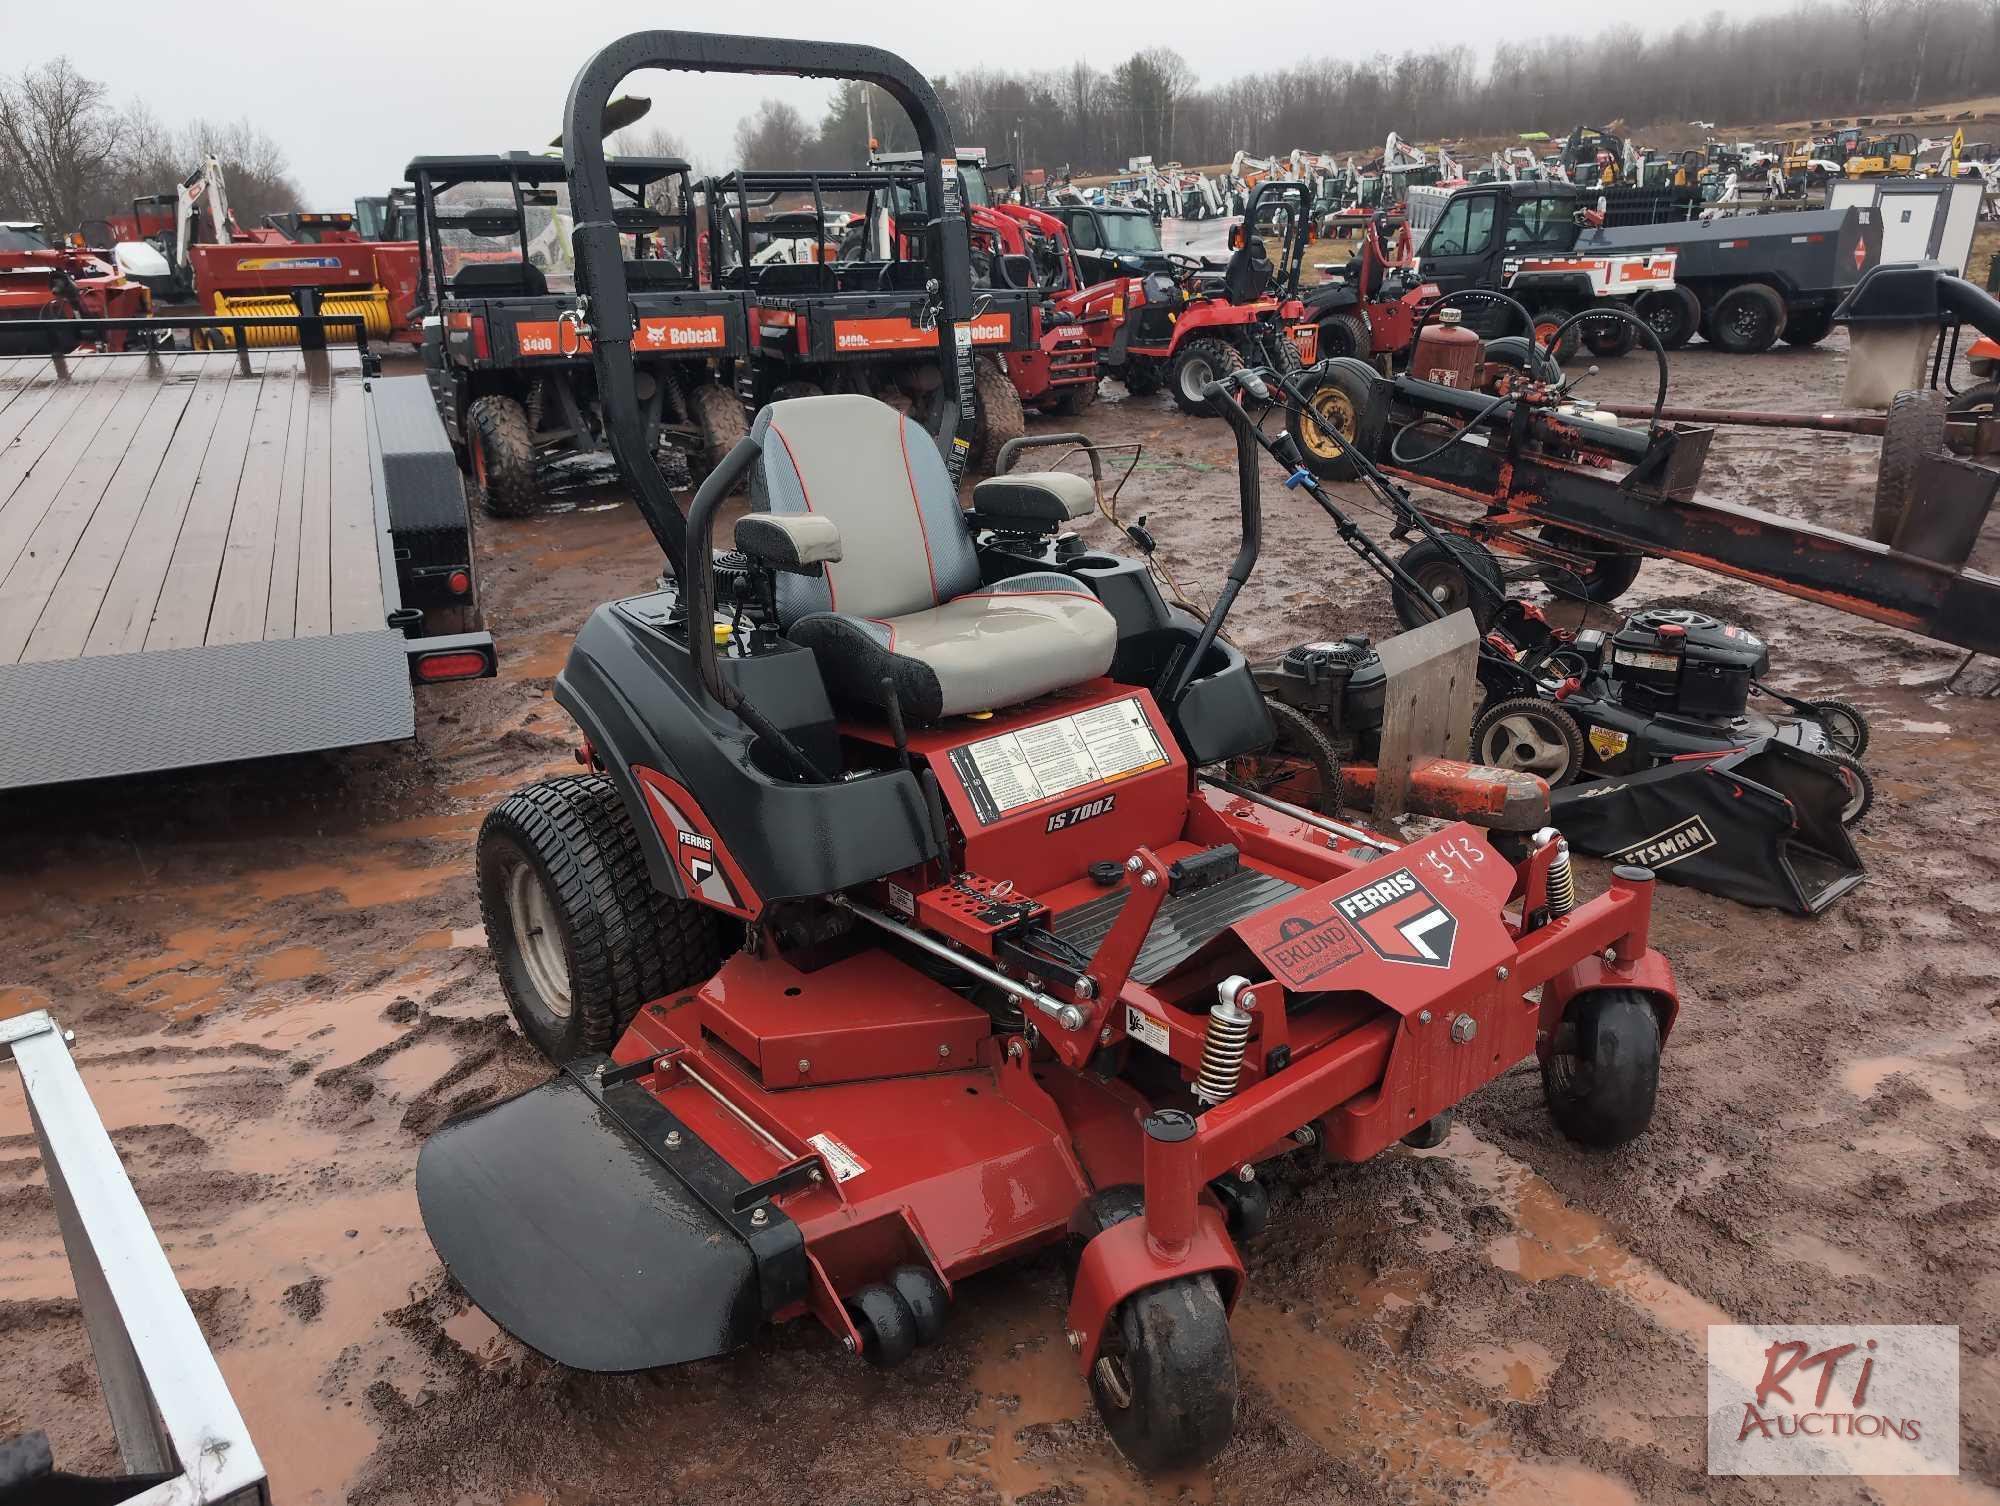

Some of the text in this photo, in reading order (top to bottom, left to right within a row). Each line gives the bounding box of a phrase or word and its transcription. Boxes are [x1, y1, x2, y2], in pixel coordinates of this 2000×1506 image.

[522, 336, 552, 352] 3400
[669, 327, 718, 345] Bobcat
[971, 324, 1004, 340] obcat
[1047, 813, 1067, 832] IS
[1070, 796, 1115, 825] 700Z
[679, 831, 711, 851] FERRIS
[1426, 837, 1485, 880] 543
[1339, 871, 1418, 919] FERRIS
[1275, 927, 1346, 968] EKLUND
